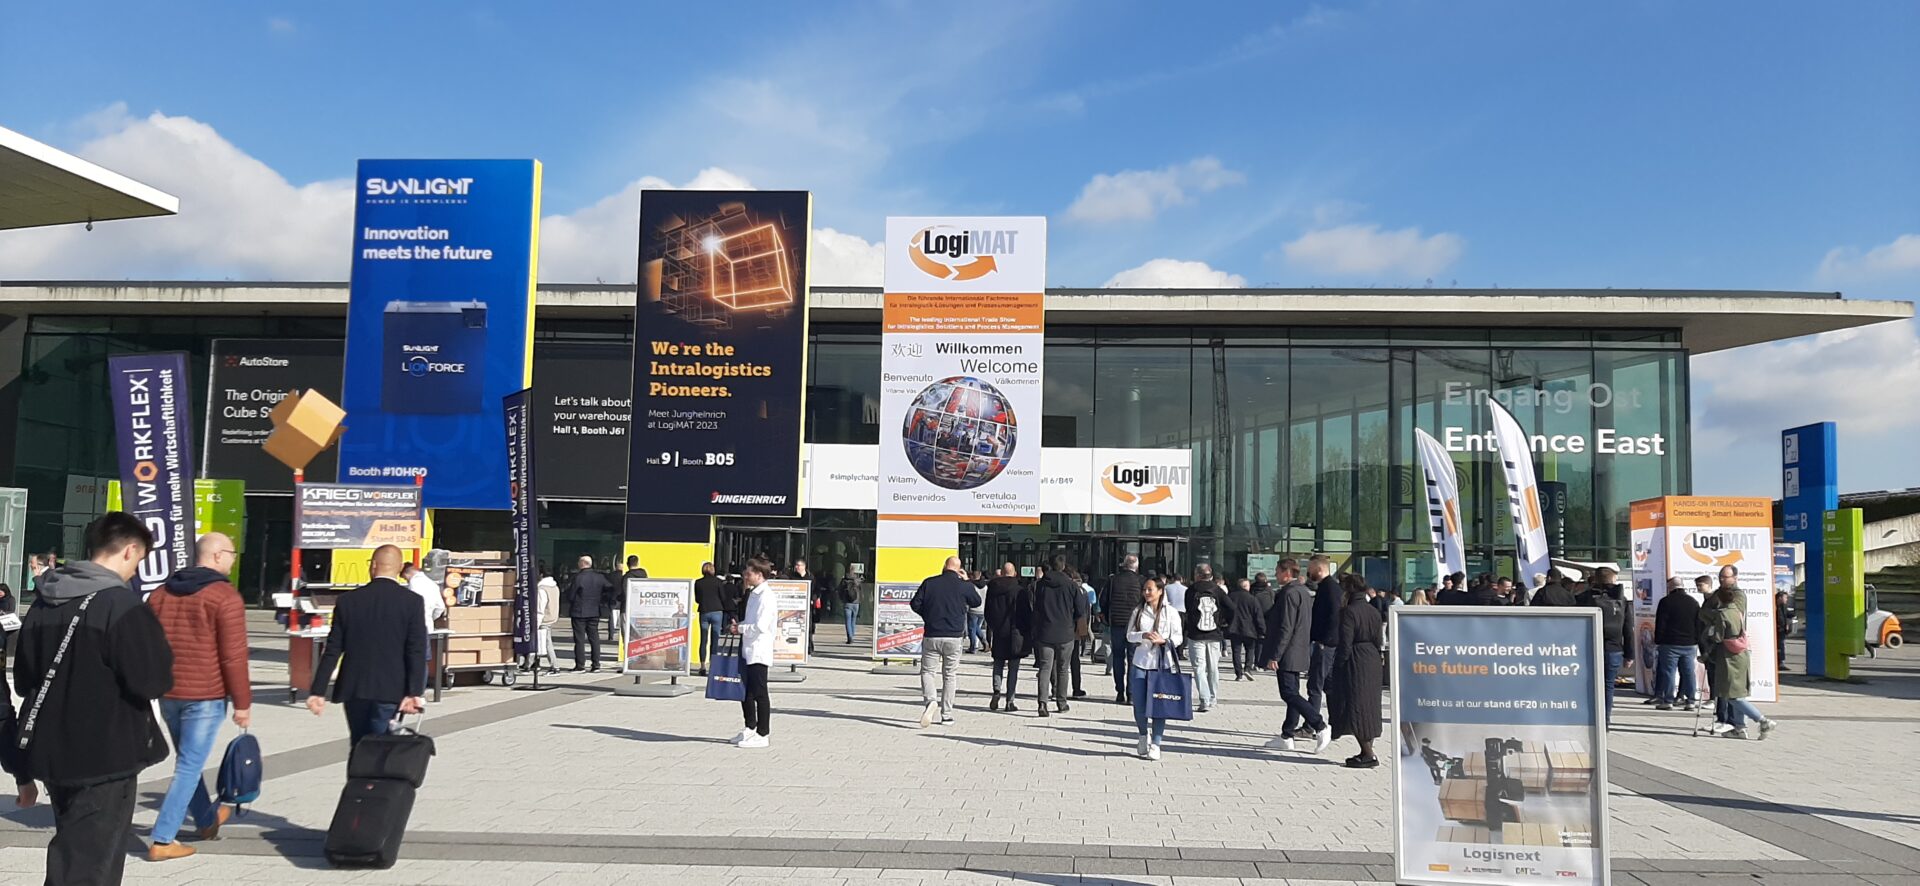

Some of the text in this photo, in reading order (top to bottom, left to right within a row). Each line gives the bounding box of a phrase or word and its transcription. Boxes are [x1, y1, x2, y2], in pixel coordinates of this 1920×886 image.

[366, 178, 473, 195] SUNLIGHT
[364, 226, 449, 240] Innovation
[924, 230, 1018, 258] LogiMAT
[363, 246, 493, 260] meets the future
[651, 341, 735, 356] We're the
[891, 343, 923, 357] 欢迎
[936, 343, 1022, 354] Willkommen
[239, 357, 290, 366] AutoStore
[961, 359, 1038, 374] Welcome
[650, 361, 772, 379] Intralogistics
[884, 373, 933, 382] Benvenuto
[225, 389, 248, 401] The
[649, 382, 732, 397] Pioneers.
[555, 396, 631, 407] Let's talk about
[1445, 382, 1642, 414] Eingang Ost
[223, 406, 257, 418] Cube
[554, 412, 576, 421] your
[648, 410, 726, 420] Meet Jungheinrich
[159, 369, 179, 470] Wirtschaftlichkeit
[658, 421, 694, 431] LogiMAT
[696, 422, 718, 430] 2023
[553, 425, 571, 434] Hall
[581, 426, 608, 435] Booth
[609, 427, 625, 435] J61
[129, 376, 159, 505] WORKFLEX
[1445, 427, 1665, 455] Entnce East
[646, 452, 735, 466] Hall 9 Booth B05
[349, 466, 428, 477] Booth #10H60
[1113, 465, 1190, 487] LogiMAT
[167, 470, 182, 501] mehr
[887, 475, 918, 484] Witamy
[302, 488, 360, 500] KRIEG
[711, 493, 786, 504] JUNGHEINRICH
[893, 493, 946, 502] Bienvenidos
[972, 491, 1017, 500] Tervetuloa
[170, 505, 183, 522] für
[1673, 509, 1710, 518] Connecting
[520, 517, 528, 532] für
[1801, 512, 1808, 530] B
[1693, 533, 1757, 551] LogiMAT
[521, 533, 530, 598] Arbeitsplätze
[523, 599, 531, 642] Gesunde
[53, 616, 80, 664] SUPREME
[1415, 643, 1577, 657] Ever wondered what
[1413, 662, 1580, 676] the future looks like?
[1417, 698, 1440, 707] Meet
[1455, 699, 1465, 708] at
[1466, 700, 1481, 708] our
[1484, 699, 1511, 709] stand
[1513, 700, 1537, 709] 6F20
[1539, 701, 1548, 709] in
[1550, 701, 1569, 709] hall
[1571, 701, 1577, 709] 6
[1463, 847, 1541, 862] Logisnext
